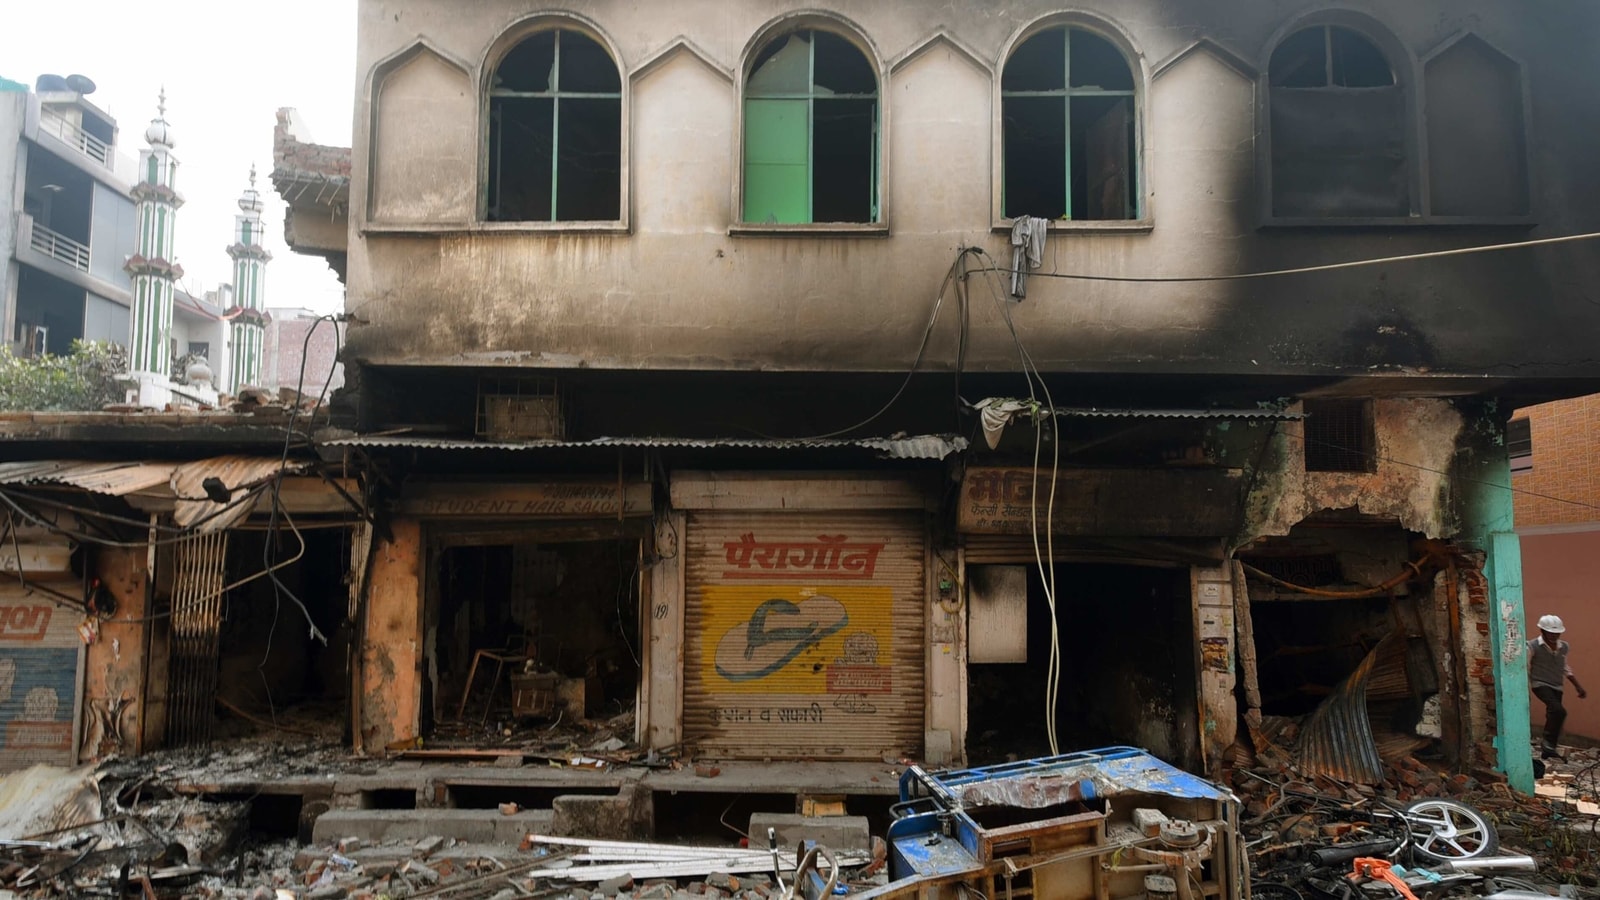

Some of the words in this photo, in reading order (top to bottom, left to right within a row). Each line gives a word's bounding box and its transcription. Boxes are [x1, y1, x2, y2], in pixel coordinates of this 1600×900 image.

[422, 498, 519, 514] STUDENT
[523, 499, 566, 514] HAIR
[722, 532, 886, 579] पैरागॉन
